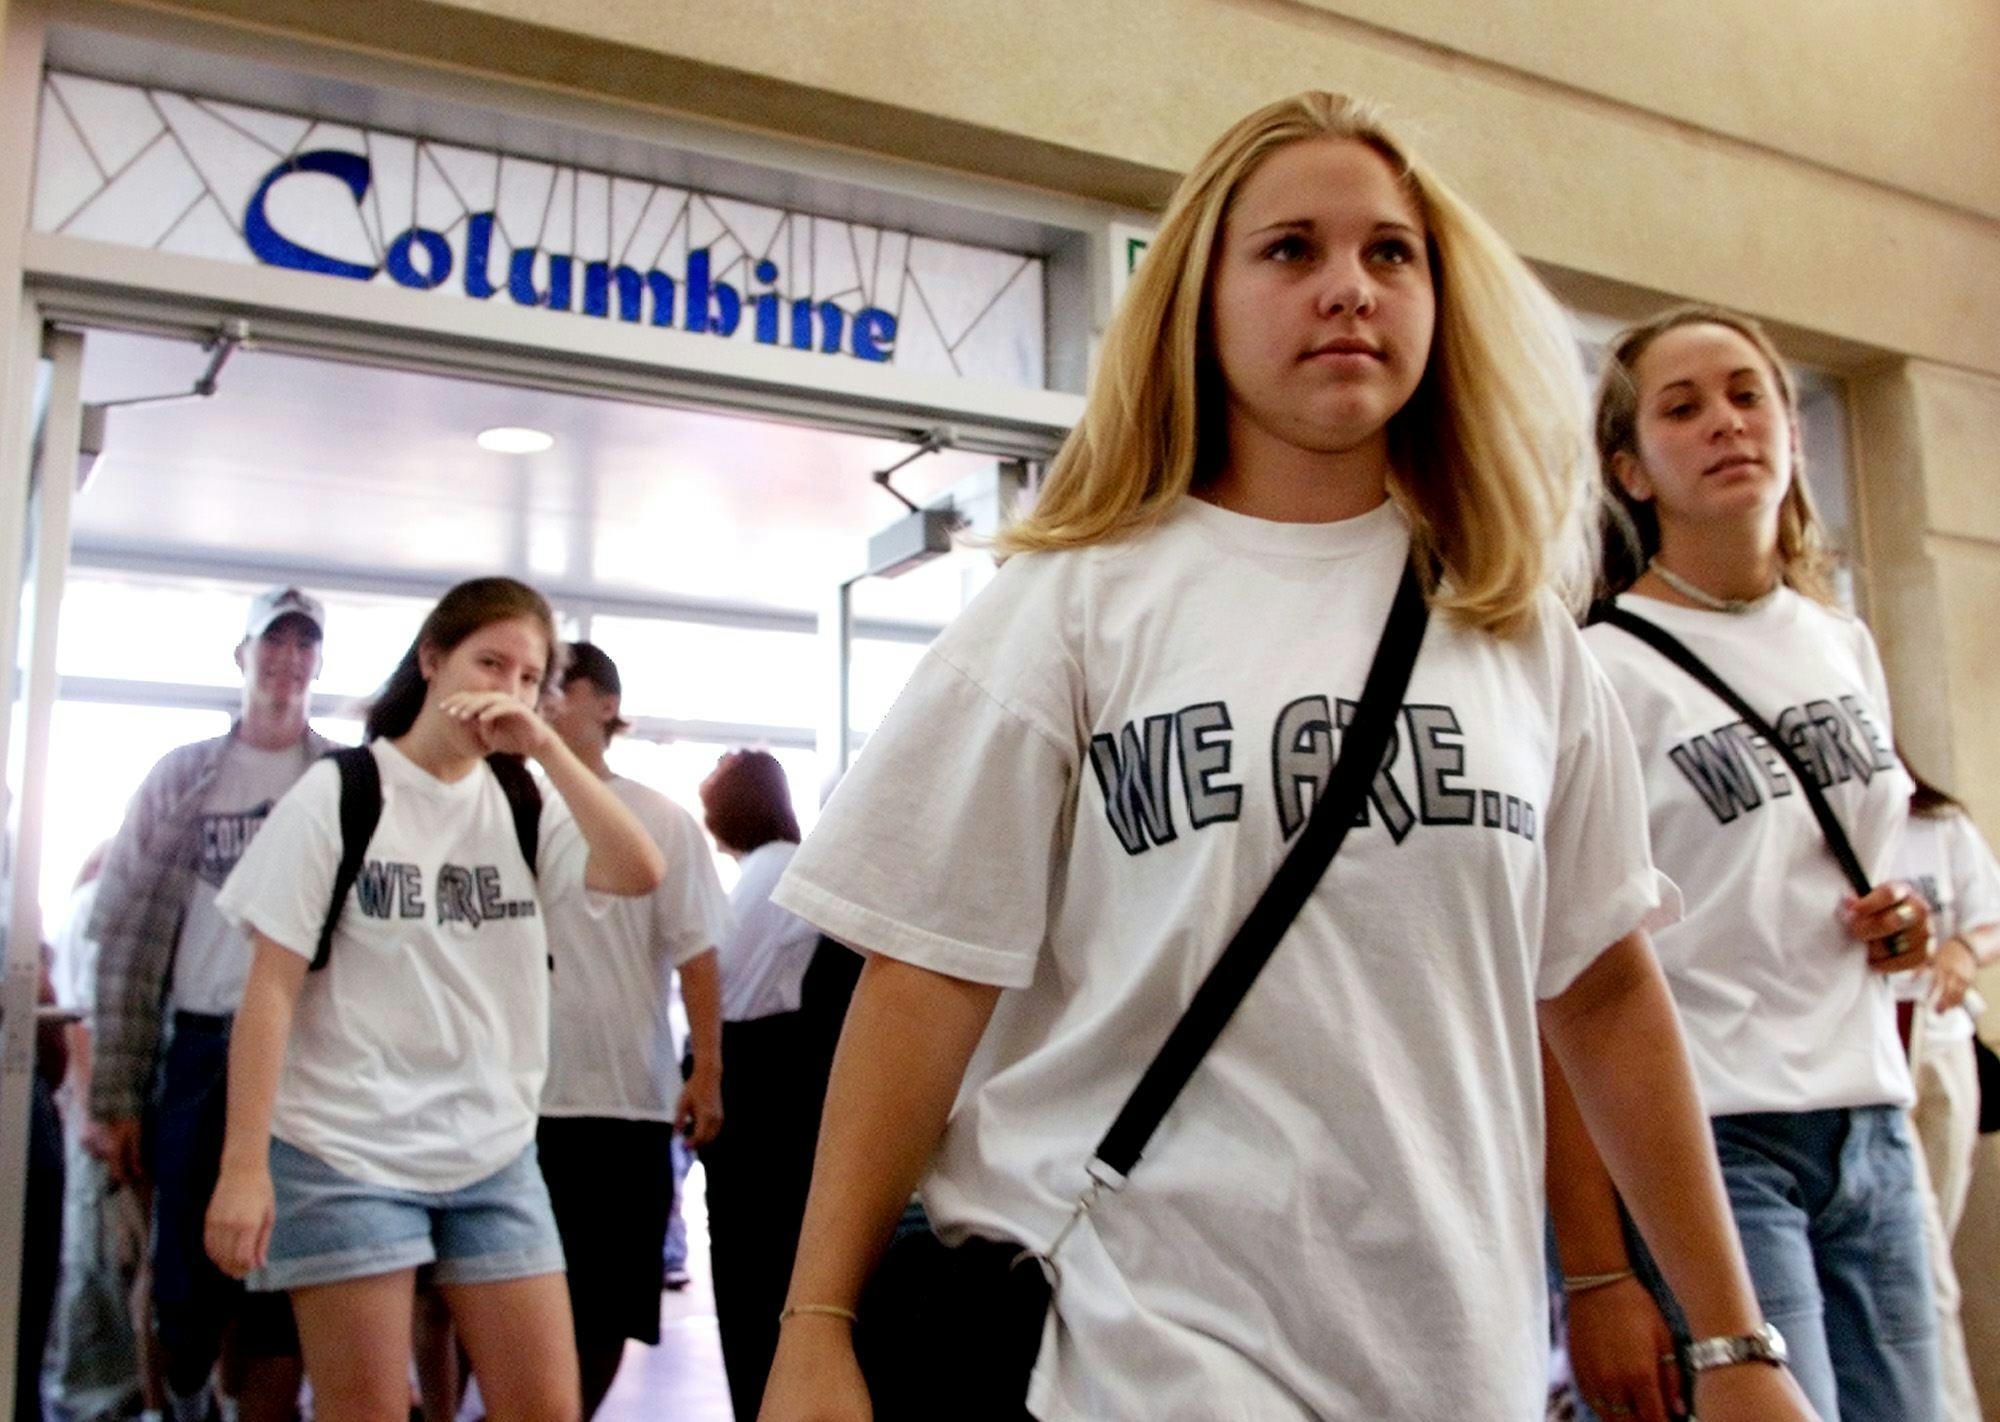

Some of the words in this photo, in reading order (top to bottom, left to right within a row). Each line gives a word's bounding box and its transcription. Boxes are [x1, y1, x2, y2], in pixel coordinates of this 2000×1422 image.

[244, 150, 898, 363] Columbine
[1089, 700, 1244, 856] WE
[1668, 719, 1793, 826] WE
[355, 860, 426, 920] WE
